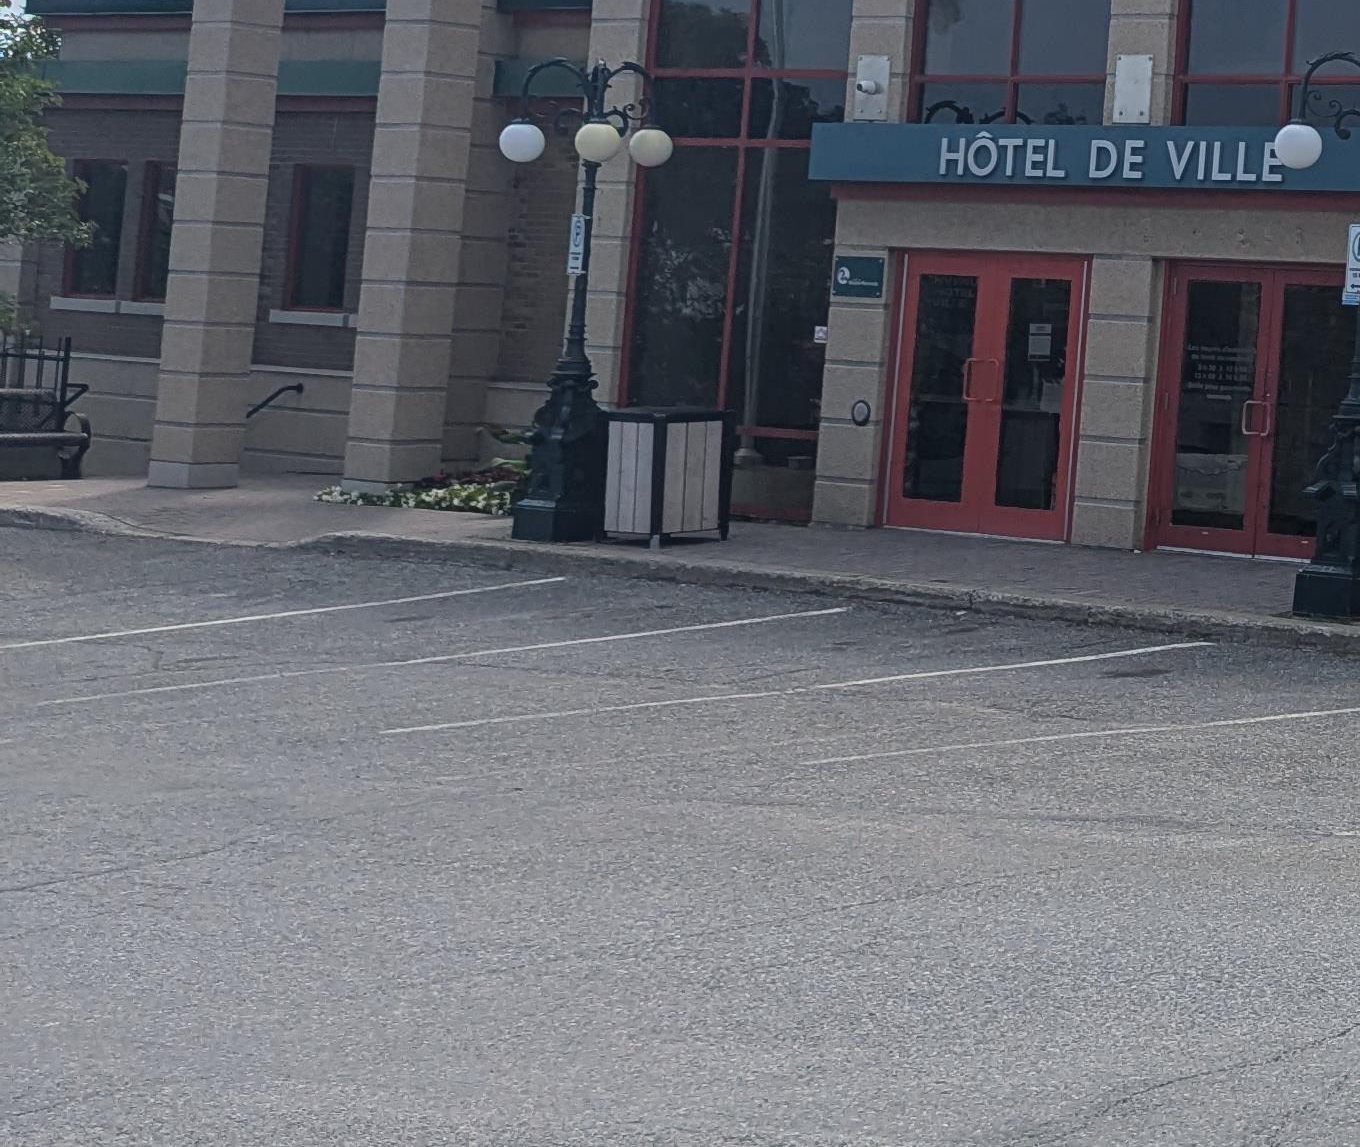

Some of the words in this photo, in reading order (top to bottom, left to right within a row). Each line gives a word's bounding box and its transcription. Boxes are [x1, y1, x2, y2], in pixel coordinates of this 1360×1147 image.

[938, 131, 1067, 179] HÔTEL
[1088, 139, 1146, 180] DE
[1166, 140, 1284, 183] VILLE
